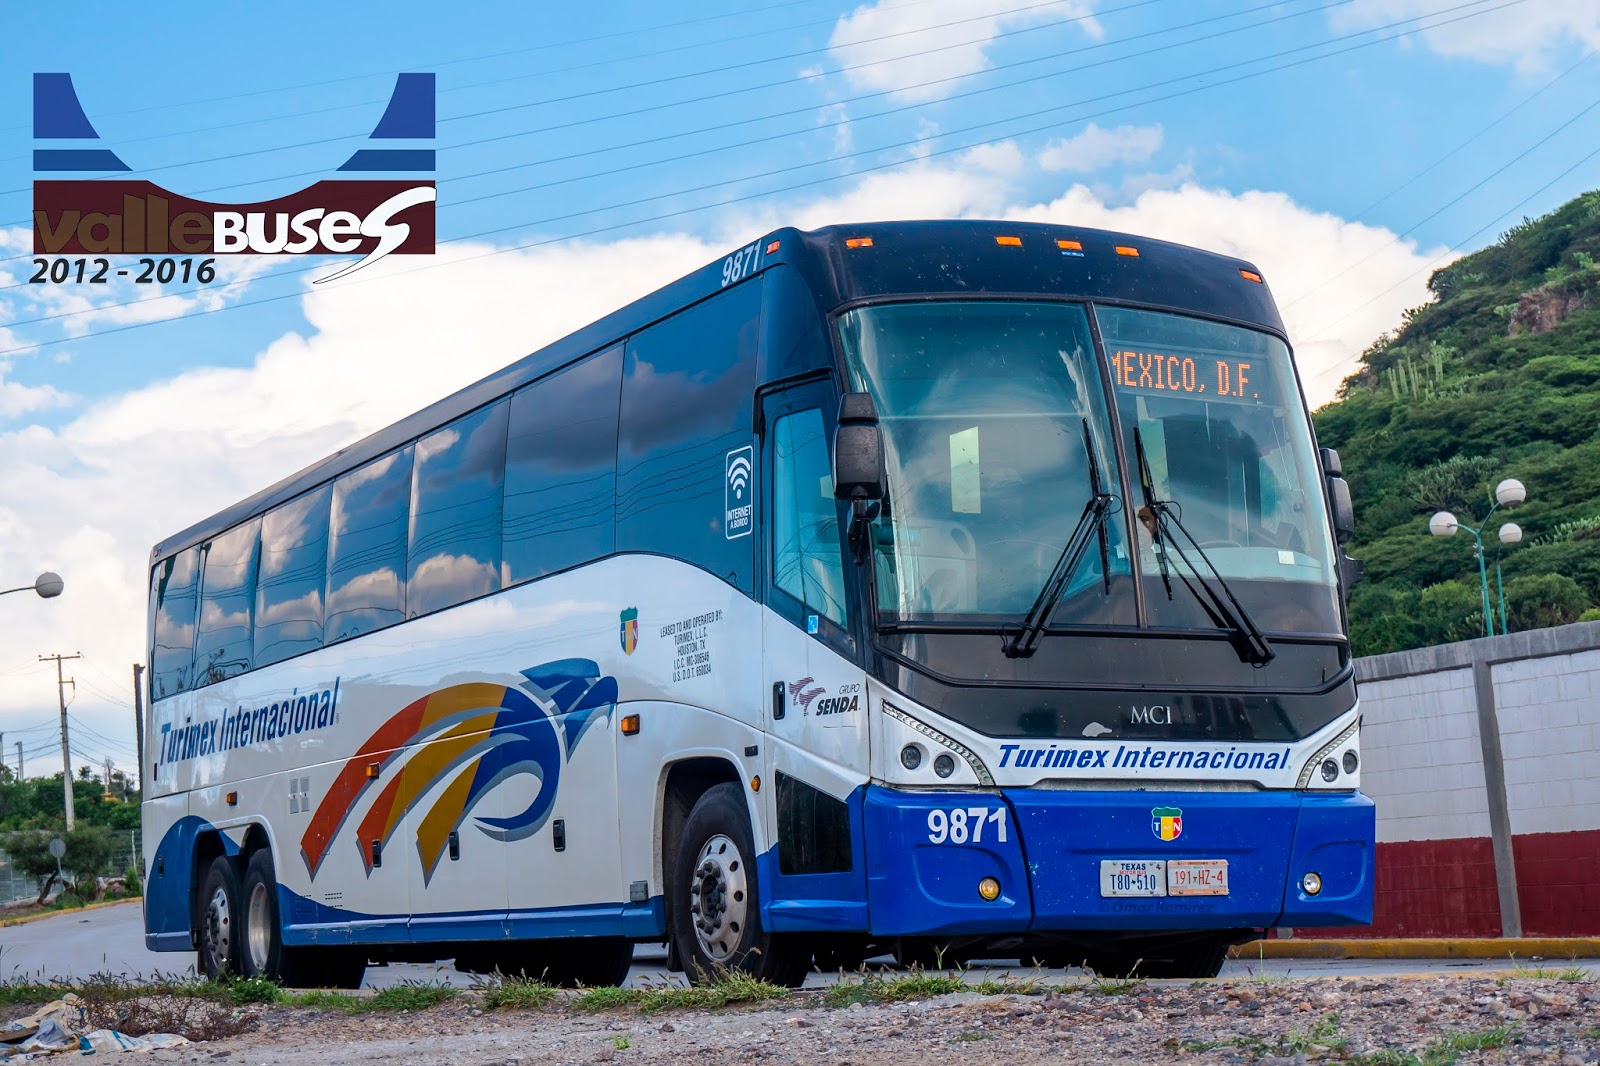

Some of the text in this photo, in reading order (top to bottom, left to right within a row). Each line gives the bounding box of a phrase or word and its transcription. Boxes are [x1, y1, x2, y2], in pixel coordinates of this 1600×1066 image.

[721, 239, 762, 288] 9871
[1216, 360, 1259, 399] D.F.
[727, 504, 752, 521] INTERNET
[734, 517, 748, 528] BORDO
[660, 624, 676, 638] LEASED
[676, 621, 682, 633] TO
[683, 619, 691, 631] AND
[693, 611, 715, 628] OPERATED
[699, 639, 706, 650] TX
[838, 683, 860, 695] GRUPO
[159, 676, 340, 766] Turimex Internacional
[1130, 705, 1172, 725] MCI
[998, 744, 1290, 770] Turimex Internacional
[927, 807, 1007, 844] 9871
